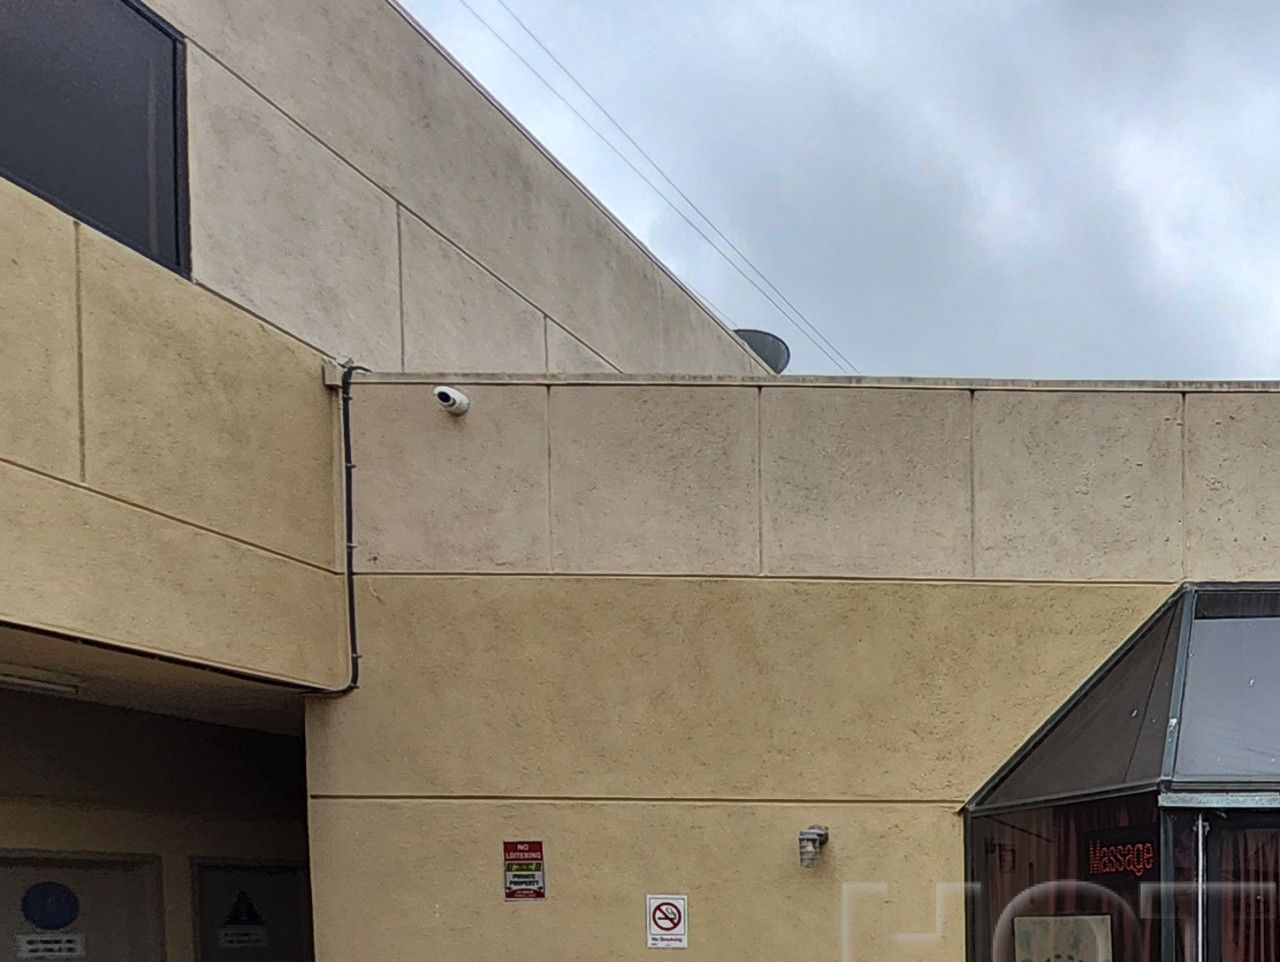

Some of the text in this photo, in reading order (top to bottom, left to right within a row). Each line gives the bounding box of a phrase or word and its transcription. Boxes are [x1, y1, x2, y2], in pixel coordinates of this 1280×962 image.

[517, 843, 529, 851] NO
[505, 851, 542, 860] LOITERING
[1089, 840, 1154, 877] Massage
